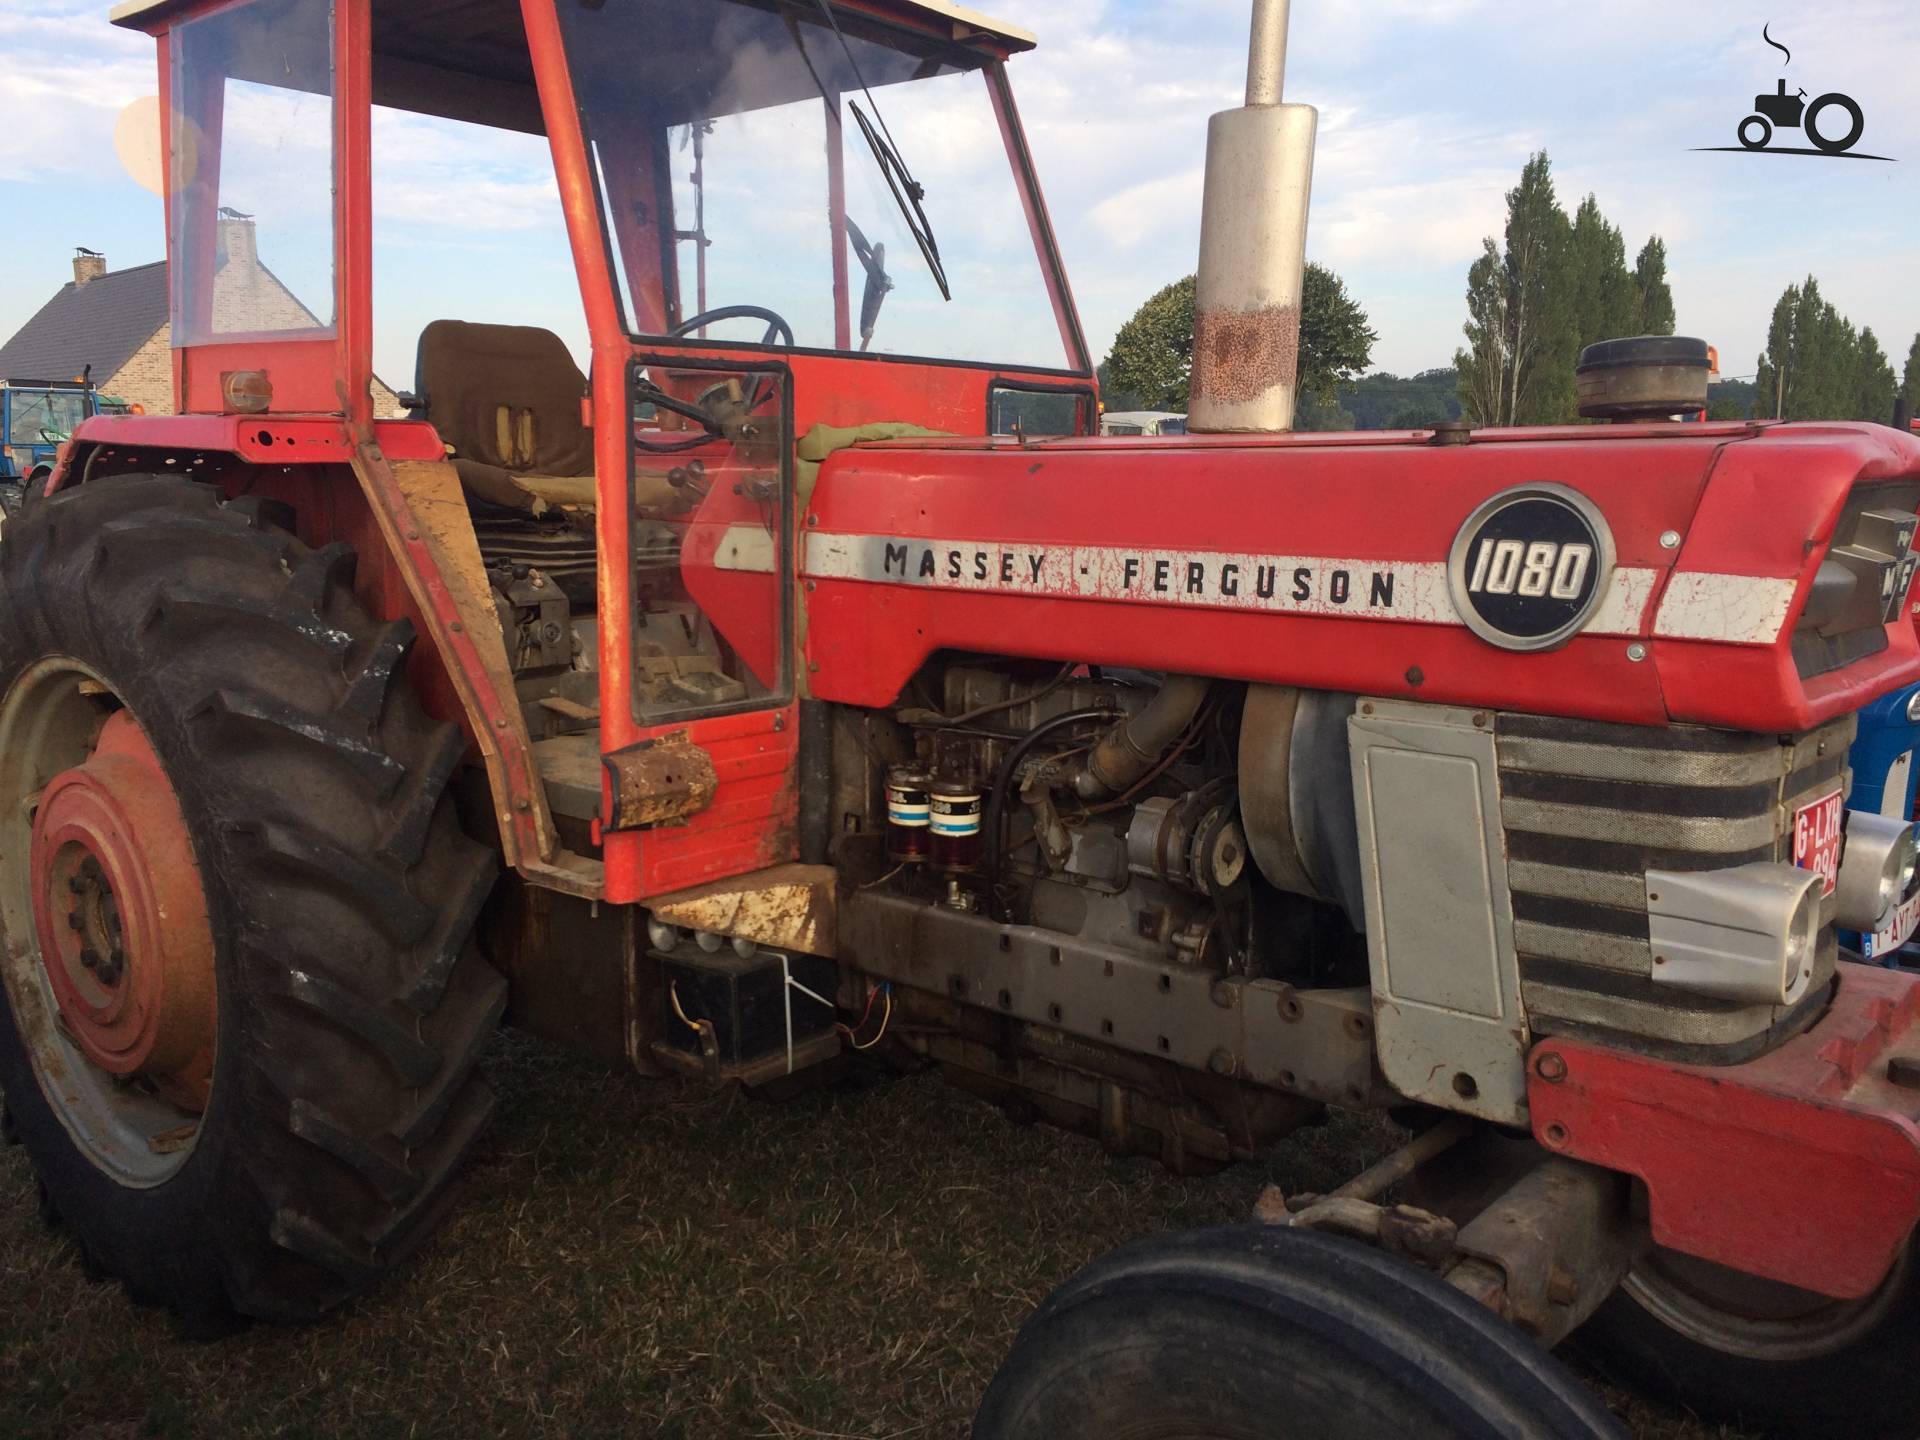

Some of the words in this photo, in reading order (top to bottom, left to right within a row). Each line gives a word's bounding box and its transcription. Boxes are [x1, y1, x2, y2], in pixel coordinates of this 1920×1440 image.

[884, 542, 1044, 584] MASSEY
[1124, 559, 1394, 608] FERGUSON
[1469, 538, 1592, 600] 1080
